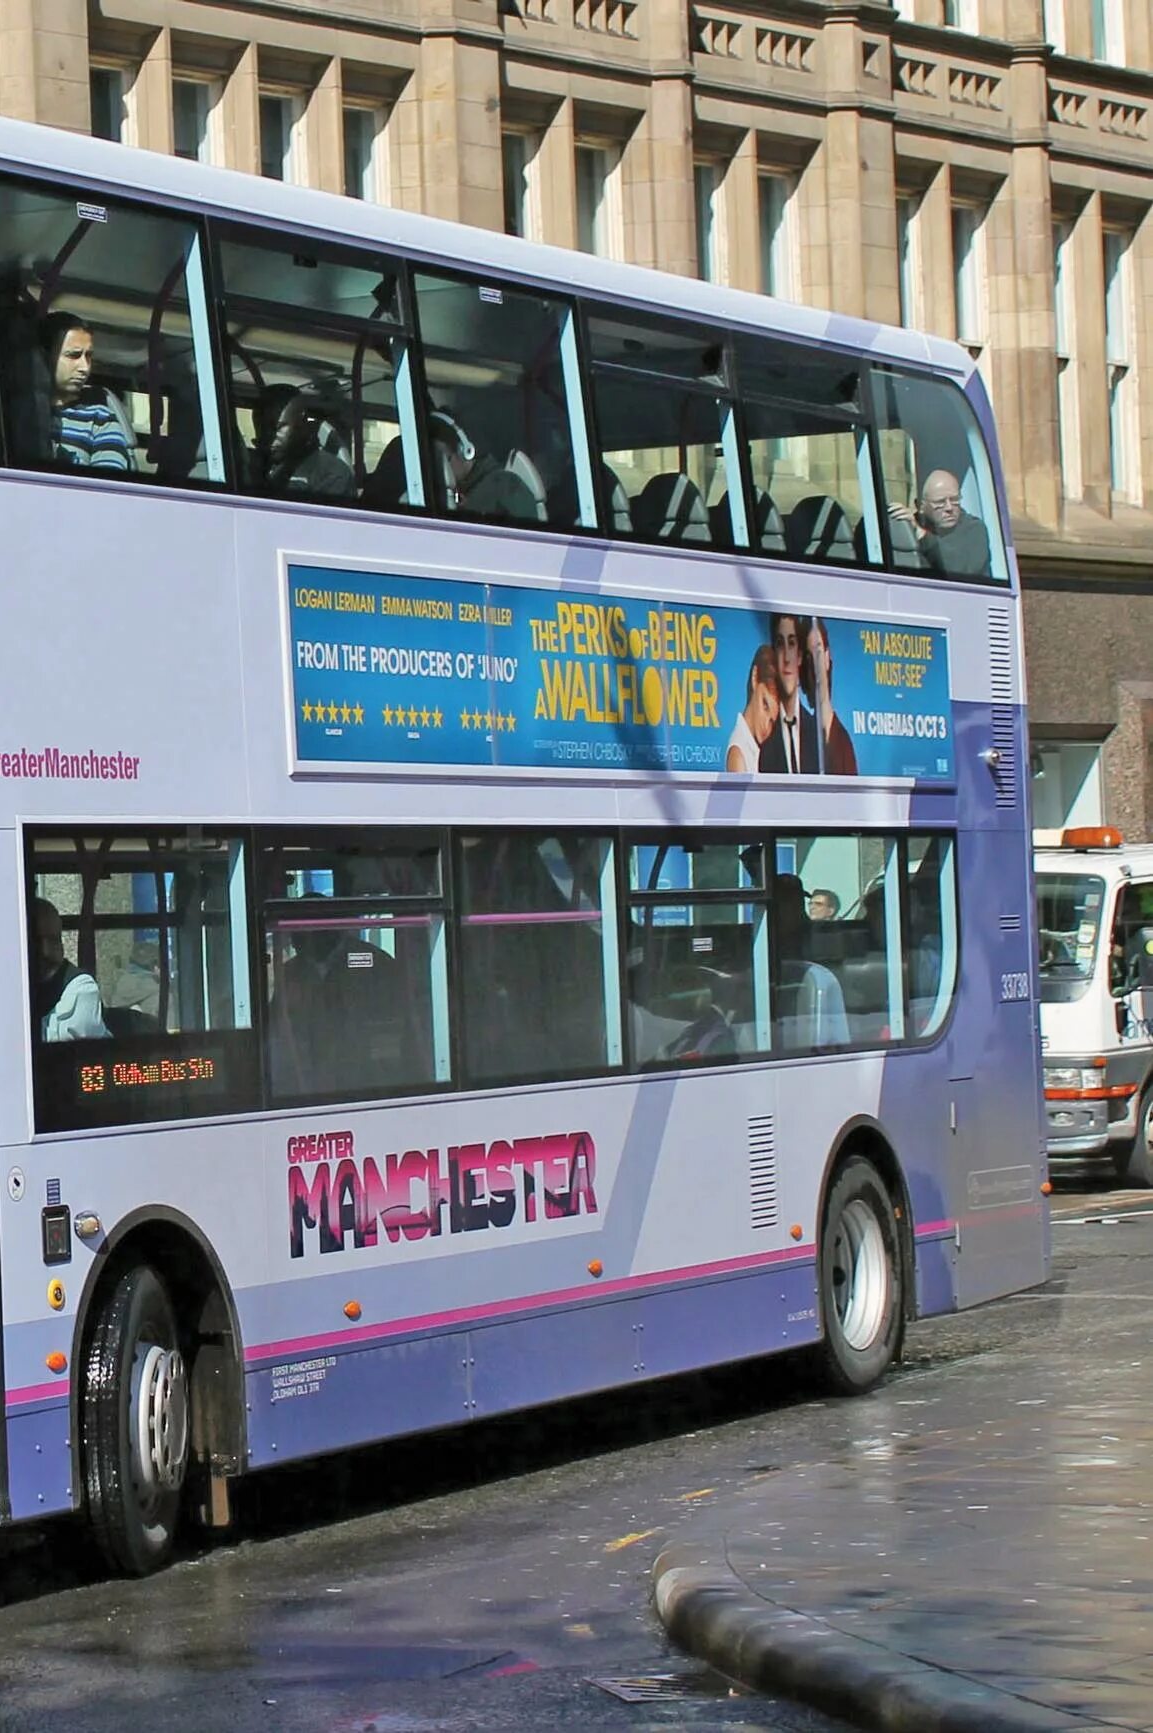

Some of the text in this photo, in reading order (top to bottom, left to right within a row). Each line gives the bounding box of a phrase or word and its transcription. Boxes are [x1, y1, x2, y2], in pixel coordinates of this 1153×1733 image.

[295, 588, 332, 610] LOGAN
[335, 592, 375, 613] LERMAN
[381, 596, 411, 617] EMMA
[411, 598, 453, 621] WATSON
[458, 603, 482, 623] EZRA
[529, 601, 716, 664] THE PERKS OF BEING
[883, 633, 933, 660] ABSOLUTE
[297, 641, 338, 671] FROM
[342, 645, 367, 672] THE
[371, 647, 452, 678] PRODUCERS
[456, 653, 474, 679] OF
[534, 658, 720, 728] A WALLFLOWER
[853, 711, 947, 739] IN CINEMAS OCT 3
[1001, 972, 1028, 999] 33738
[161, 1060, 186, 1081] Bus
[189, 1057, 214, 1079] Stn
[287, 1130, 354, 1164] GREATER
[288, 1131, 598, 1258] MANCHESTER
[306, 1369, 326, 1382] STREET
